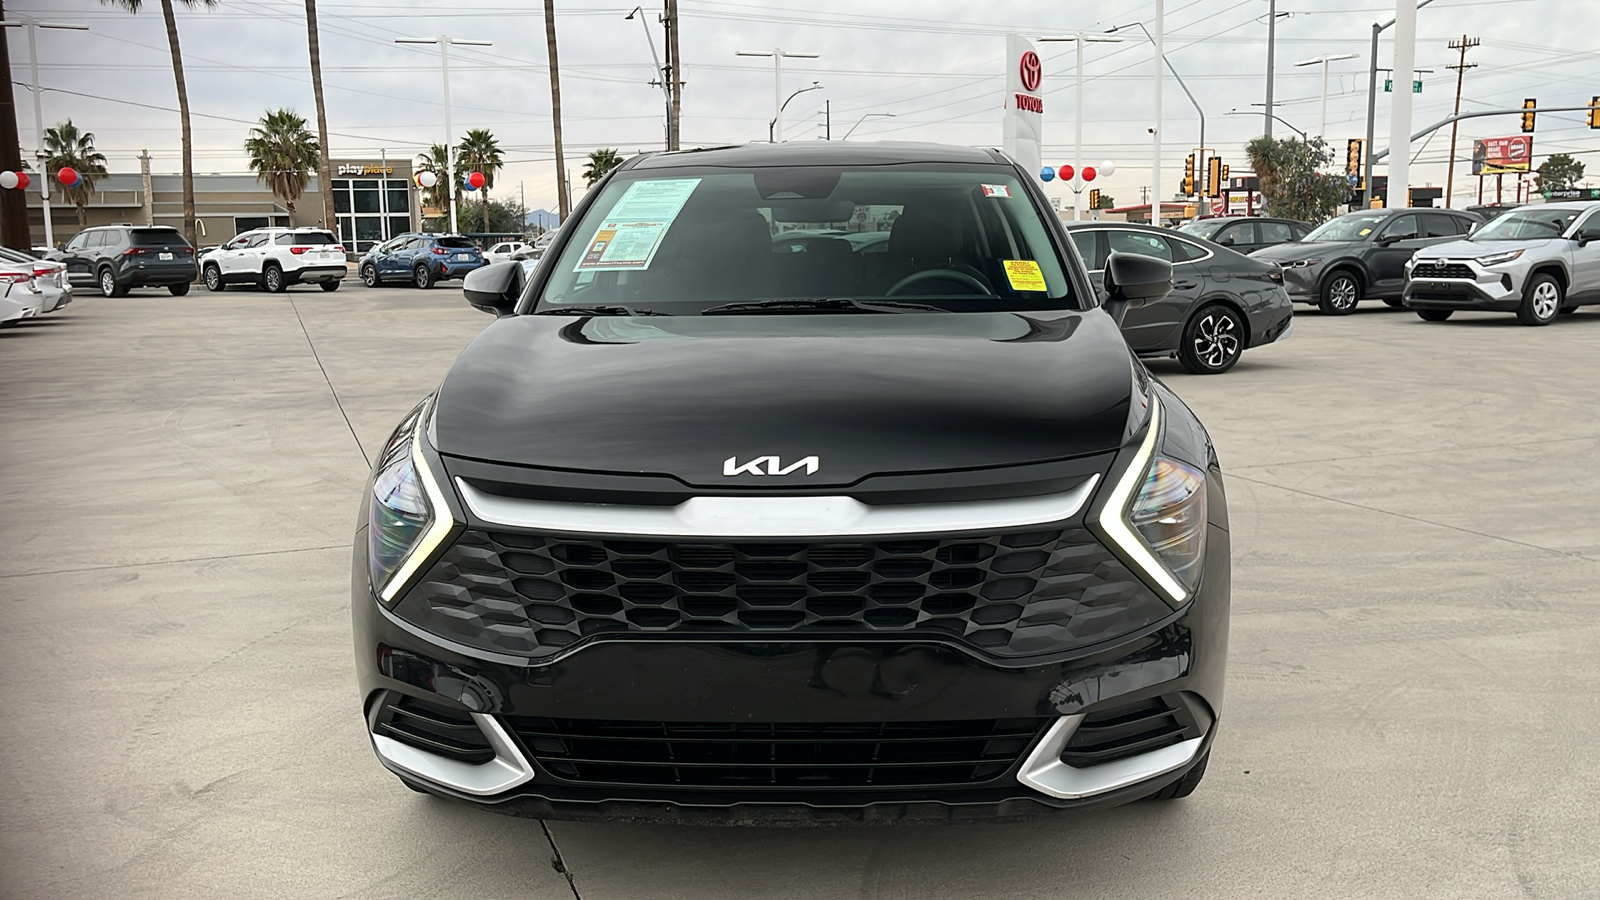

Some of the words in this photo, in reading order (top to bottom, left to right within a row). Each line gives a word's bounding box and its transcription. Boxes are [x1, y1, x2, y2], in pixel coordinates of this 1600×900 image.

[1015, 94, 1043, 113] TOYOTA
[338, 163, 393, 176] playplace
[723, 455, 819, 476] KIA
